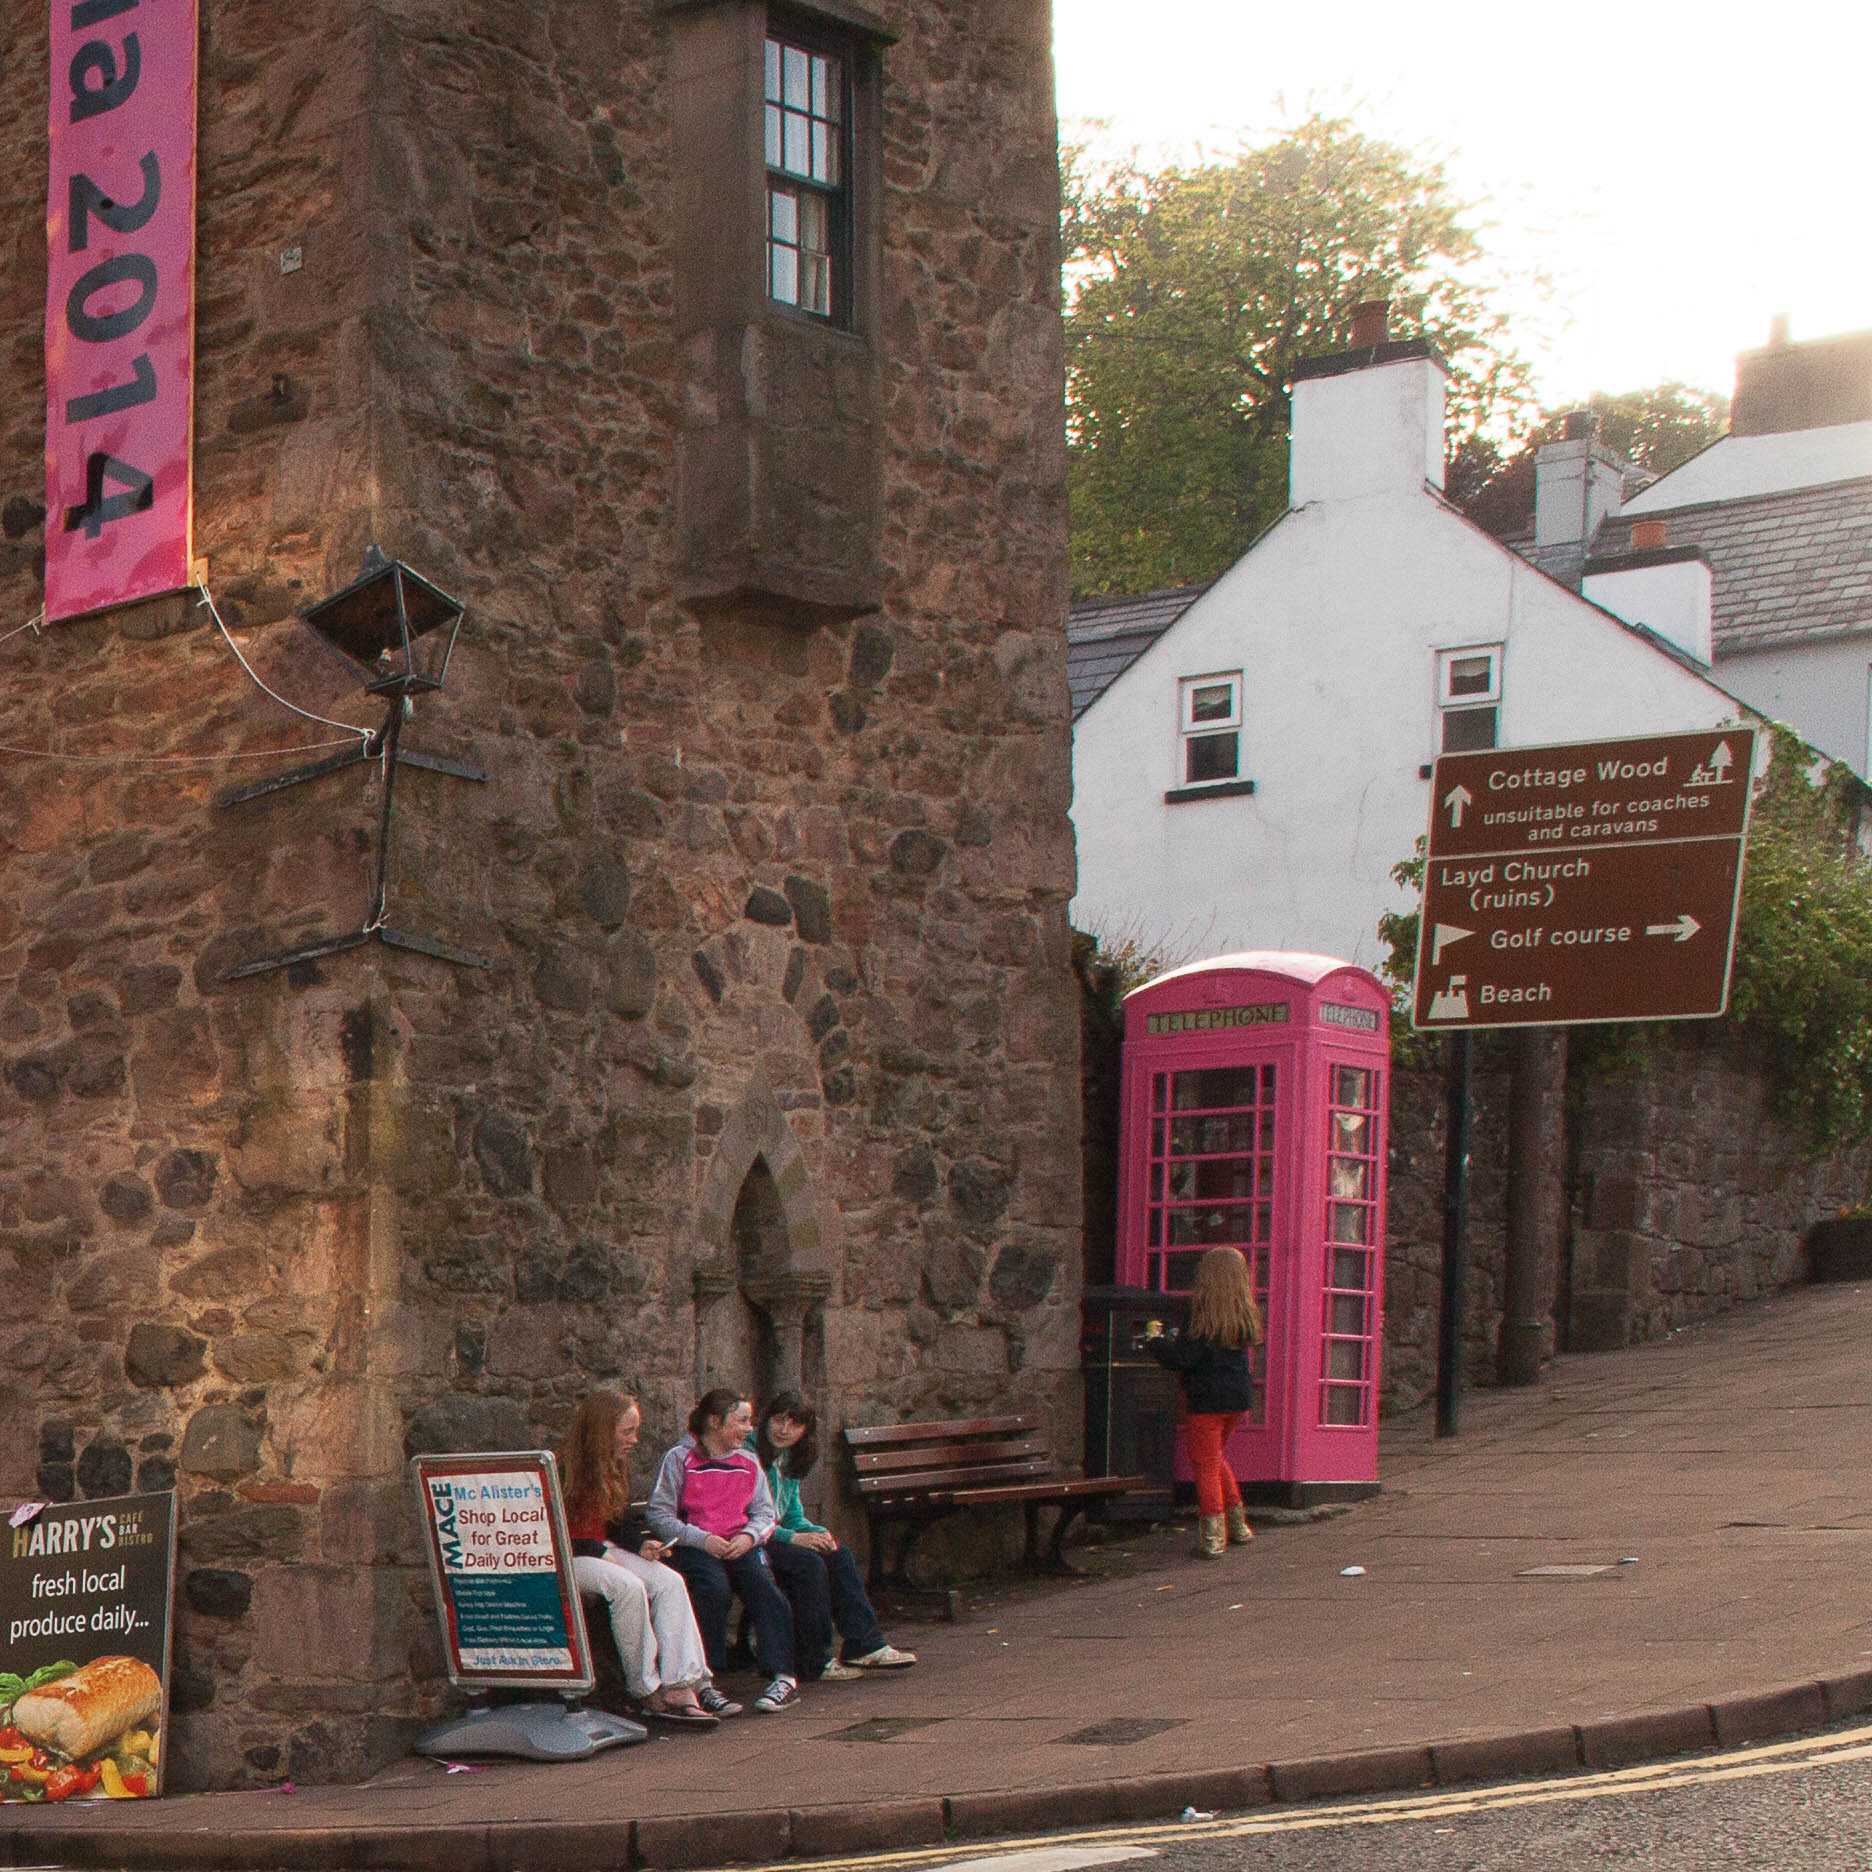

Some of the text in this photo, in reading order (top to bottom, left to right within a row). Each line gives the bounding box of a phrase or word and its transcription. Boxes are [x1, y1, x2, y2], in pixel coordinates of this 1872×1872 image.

[63, 151, 161, 541] 2014
[1488, 756, 1669, 790] Cottage Wood
[1483, 793, 1710, 825] unsuitable for coaches
[1528, 819, 1658, 841] and caravans
[1442, 858, 1590, 889] Layd Church
[1469, 883, 1555, 911] (ruins)
[1490, 925, 1631, 950] Golf course
[1479, 983, 1552, 1005] Beach
[1154, 1002, 1283, 1032] TELEPHONE
[455, 1487, 476, 1501] Mc
[118, 1523, 138, 1536] BAR
[432, 1482, 464, 1569] MACE
[459, 1506, 545, 1525] Shop Local
[12, 1514, 117, 1559] HARRY'S
[118, 1533, 154, 1547] BISTRO
[471, 1529, 538, 1545] for Great
[465, 1552, 554, 1570] Daily Offers
[32, 1565, 125, 1599] fresh local
[10, 1604, 149, 1644] produce daily...
